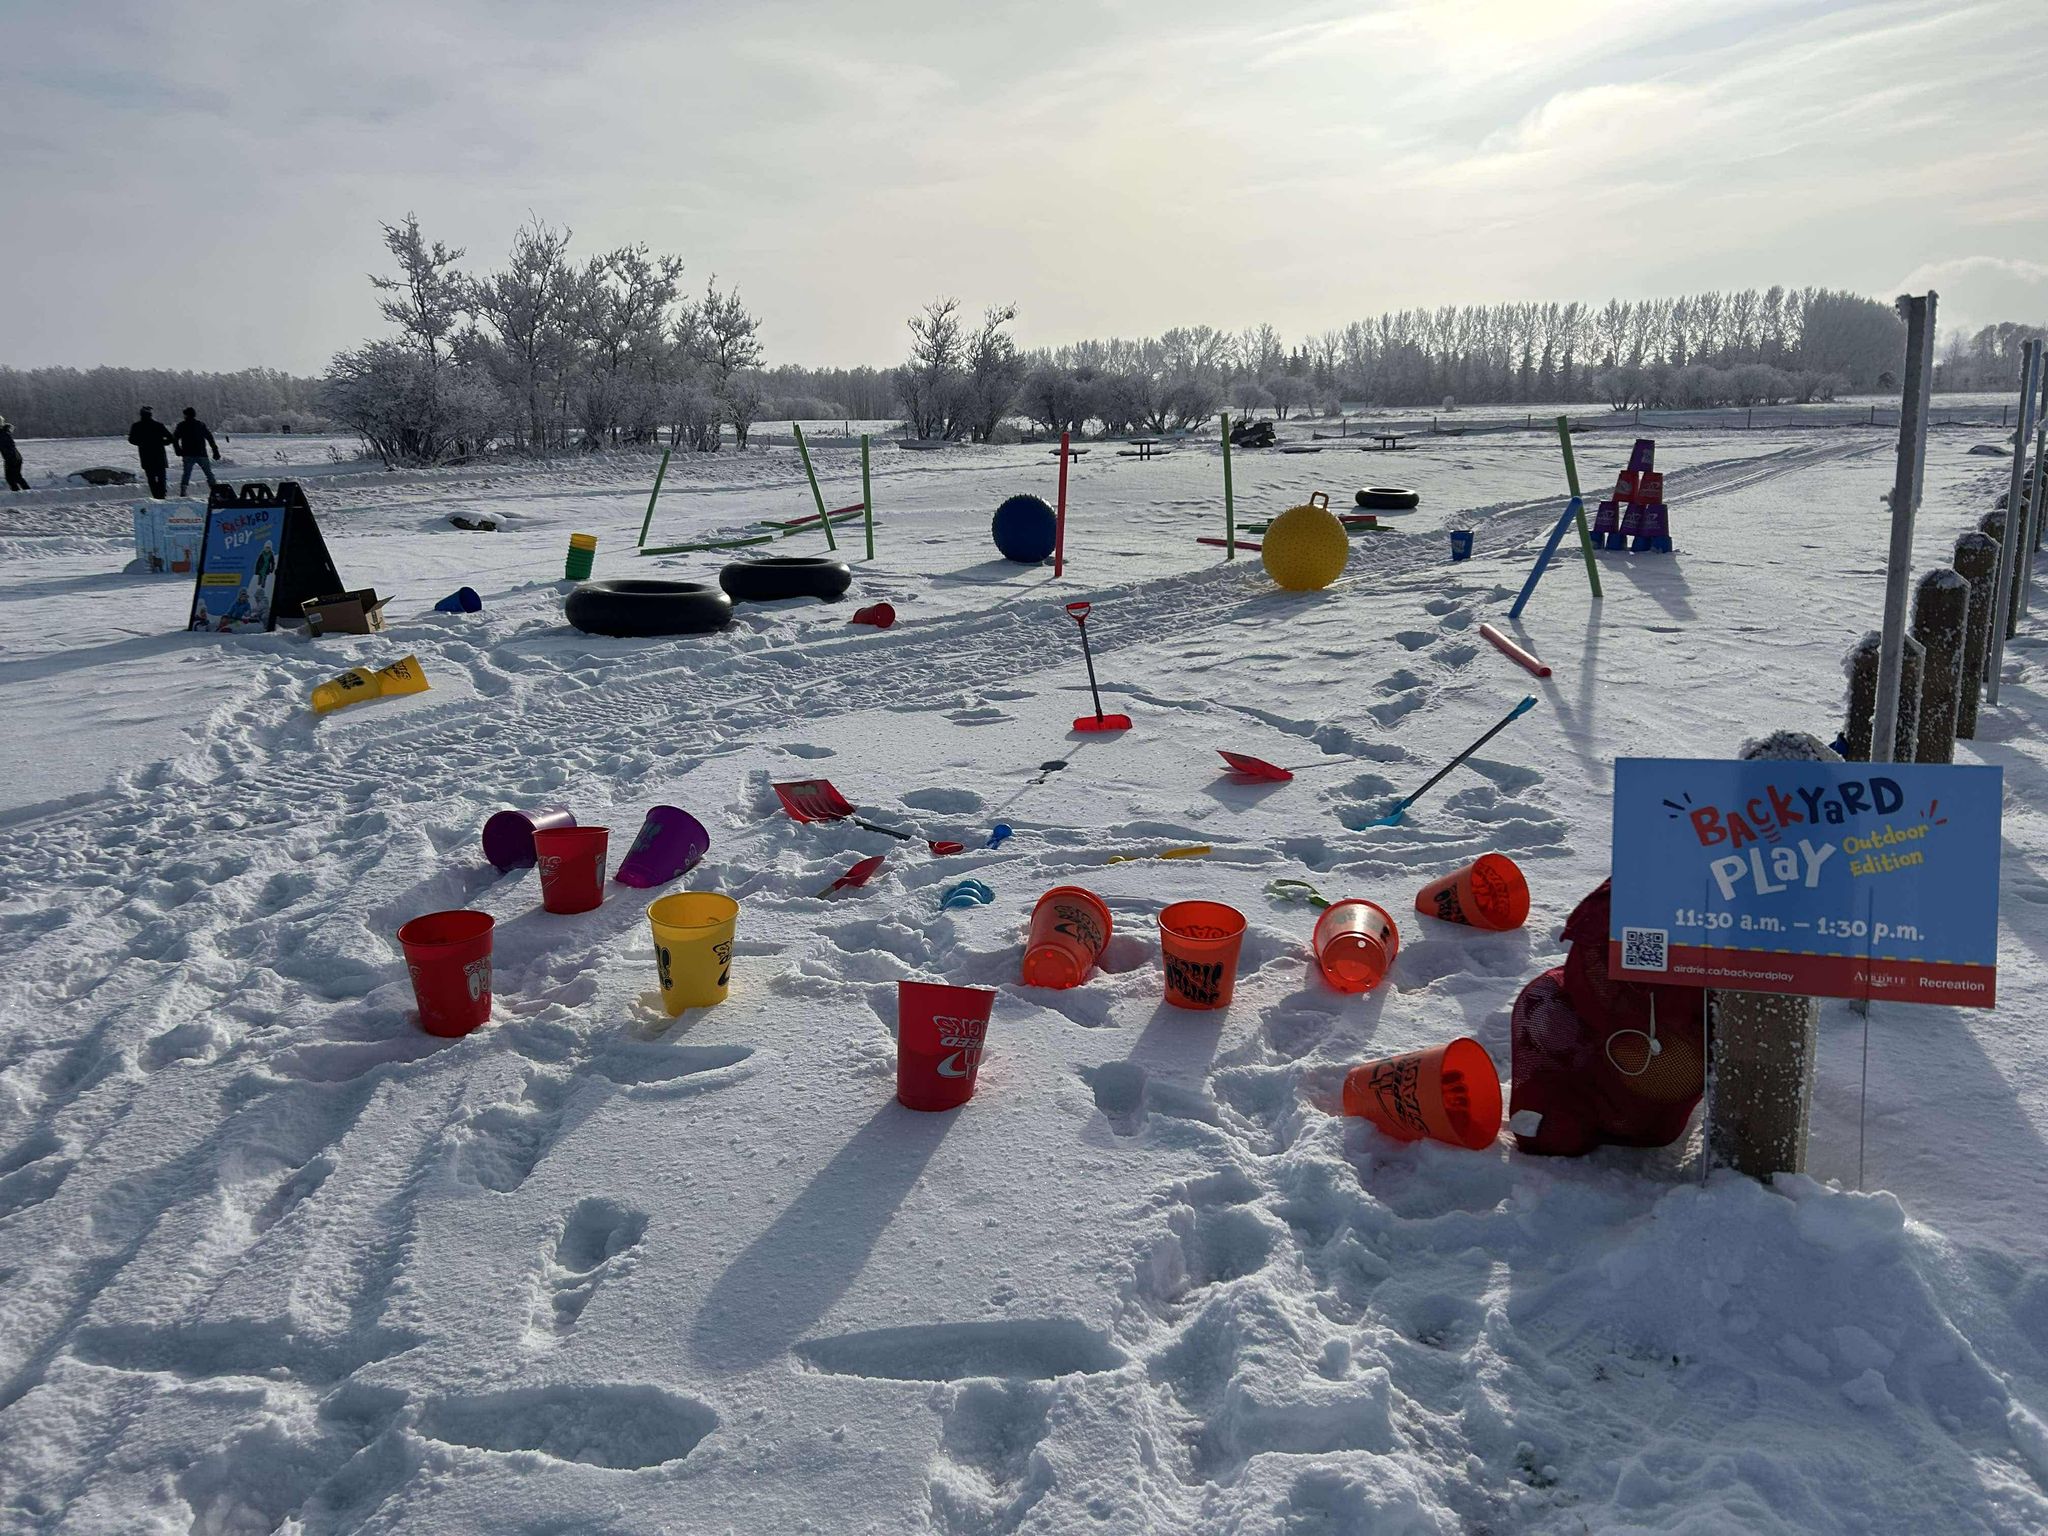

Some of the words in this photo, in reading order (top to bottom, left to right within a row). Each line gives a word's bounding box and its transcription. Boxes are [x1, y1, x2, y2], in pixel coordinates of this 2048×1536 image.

[1842, 823, 1930, 855] Outdoor
[1849, 851, 1925, 878] Edition
[1675, 908, 1734, 930] 11:30
[1740, 914, 1787, 932] a.m.
[1817, 917, 1868, 938] 1:30
[1872, 922, 1925, 945] p.m.
[1673, 965, 1795, 983] airdrie.ca/backyardplay
[1919, 976, 1986, 992] Recreation
[940, 1036, 985, 1049] PEED
